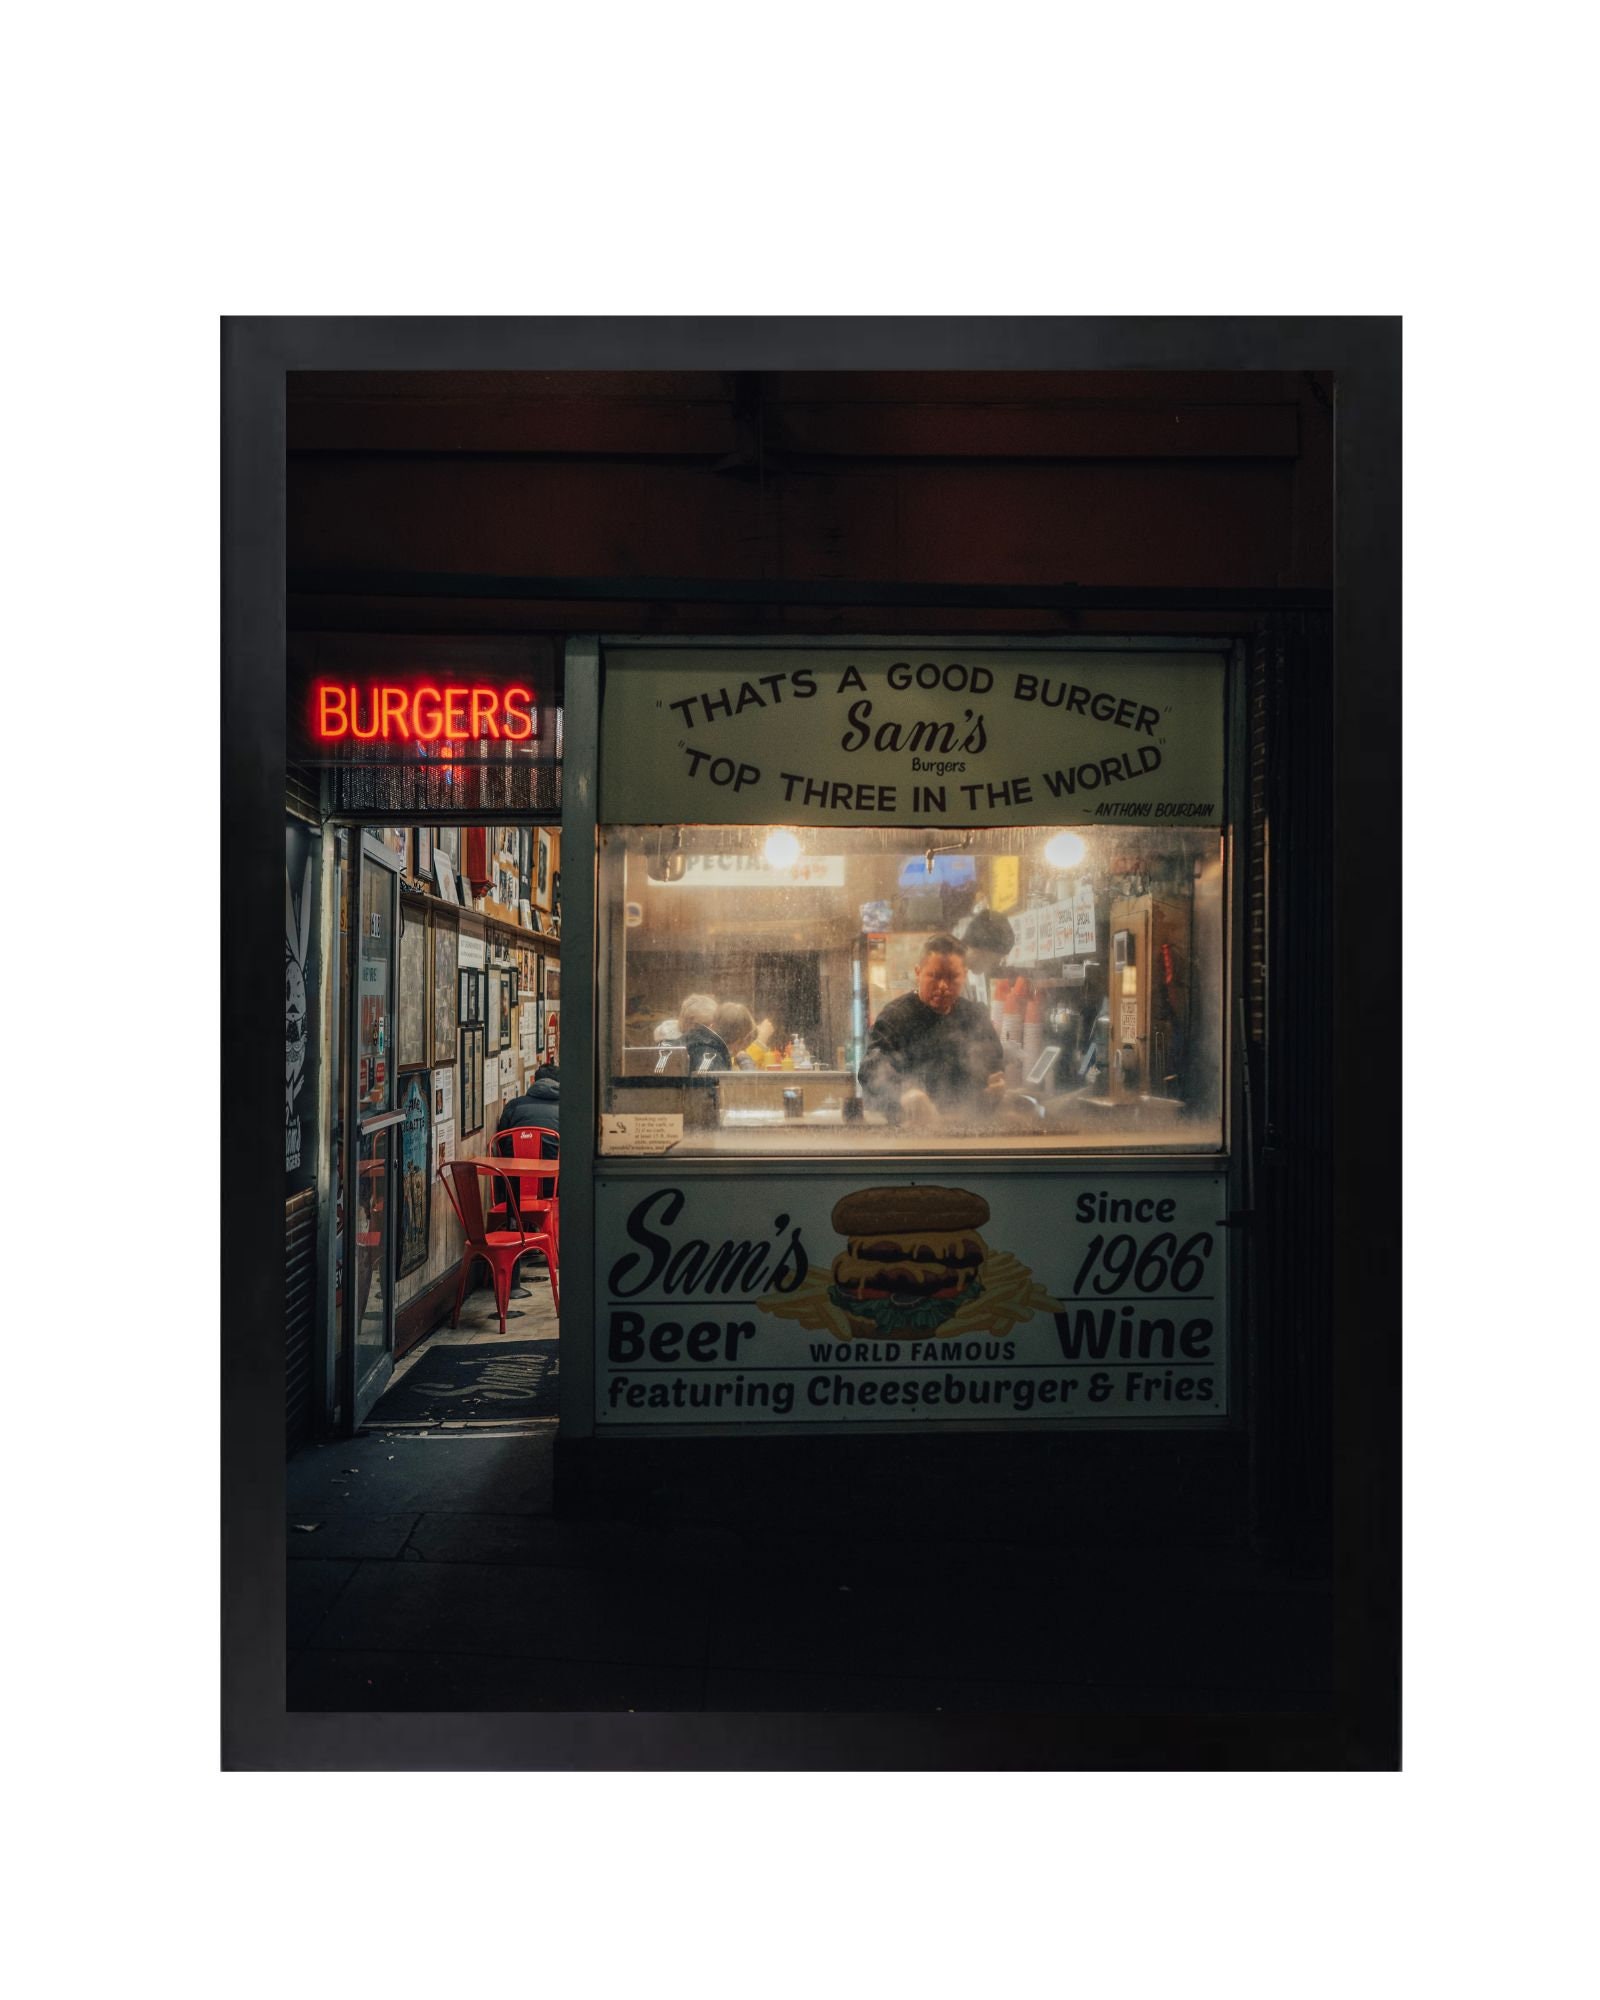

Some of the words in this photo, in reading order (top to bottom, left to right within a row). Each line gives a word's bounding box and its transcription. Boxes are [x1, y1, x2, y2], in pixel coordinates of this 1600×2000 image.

[837, 665, 867, 693] A
[887, 663, 994, 694] GOOD
[319, 685, 534, 740] BURGERS
[842, 700, 987, 754] Sam's
[912, 757, 967, 776] Burgers
[780, 772, 897, 812] THREE
[913, 785, 947, 812] IN
[960, 776, 1033, 811] THE
[1095, 802, 1152, 817] ANTHONY
[1154, 802, 1216, 817] BOURDAIN
[1075, 1190, 1176, 1224] Since
[607, 1187, 809, 1298] Sam's
[1073, 1231, 1214, 1295] 1966
[608, 1311, 756, 1363] Beer
[810, 1343, 900, 1363] WORLD
[910, 1342, 1016, 1361] FAMOUS
[1054, 1305, 1214, 1359] Wine
[607, 1375, 795, 1414] featuring
[806, 1374, 1079, 1411] Cheeseburger
[1087, 1372, 1115, 1403] &
[1125, 1370, 1214, 1402] Fries
